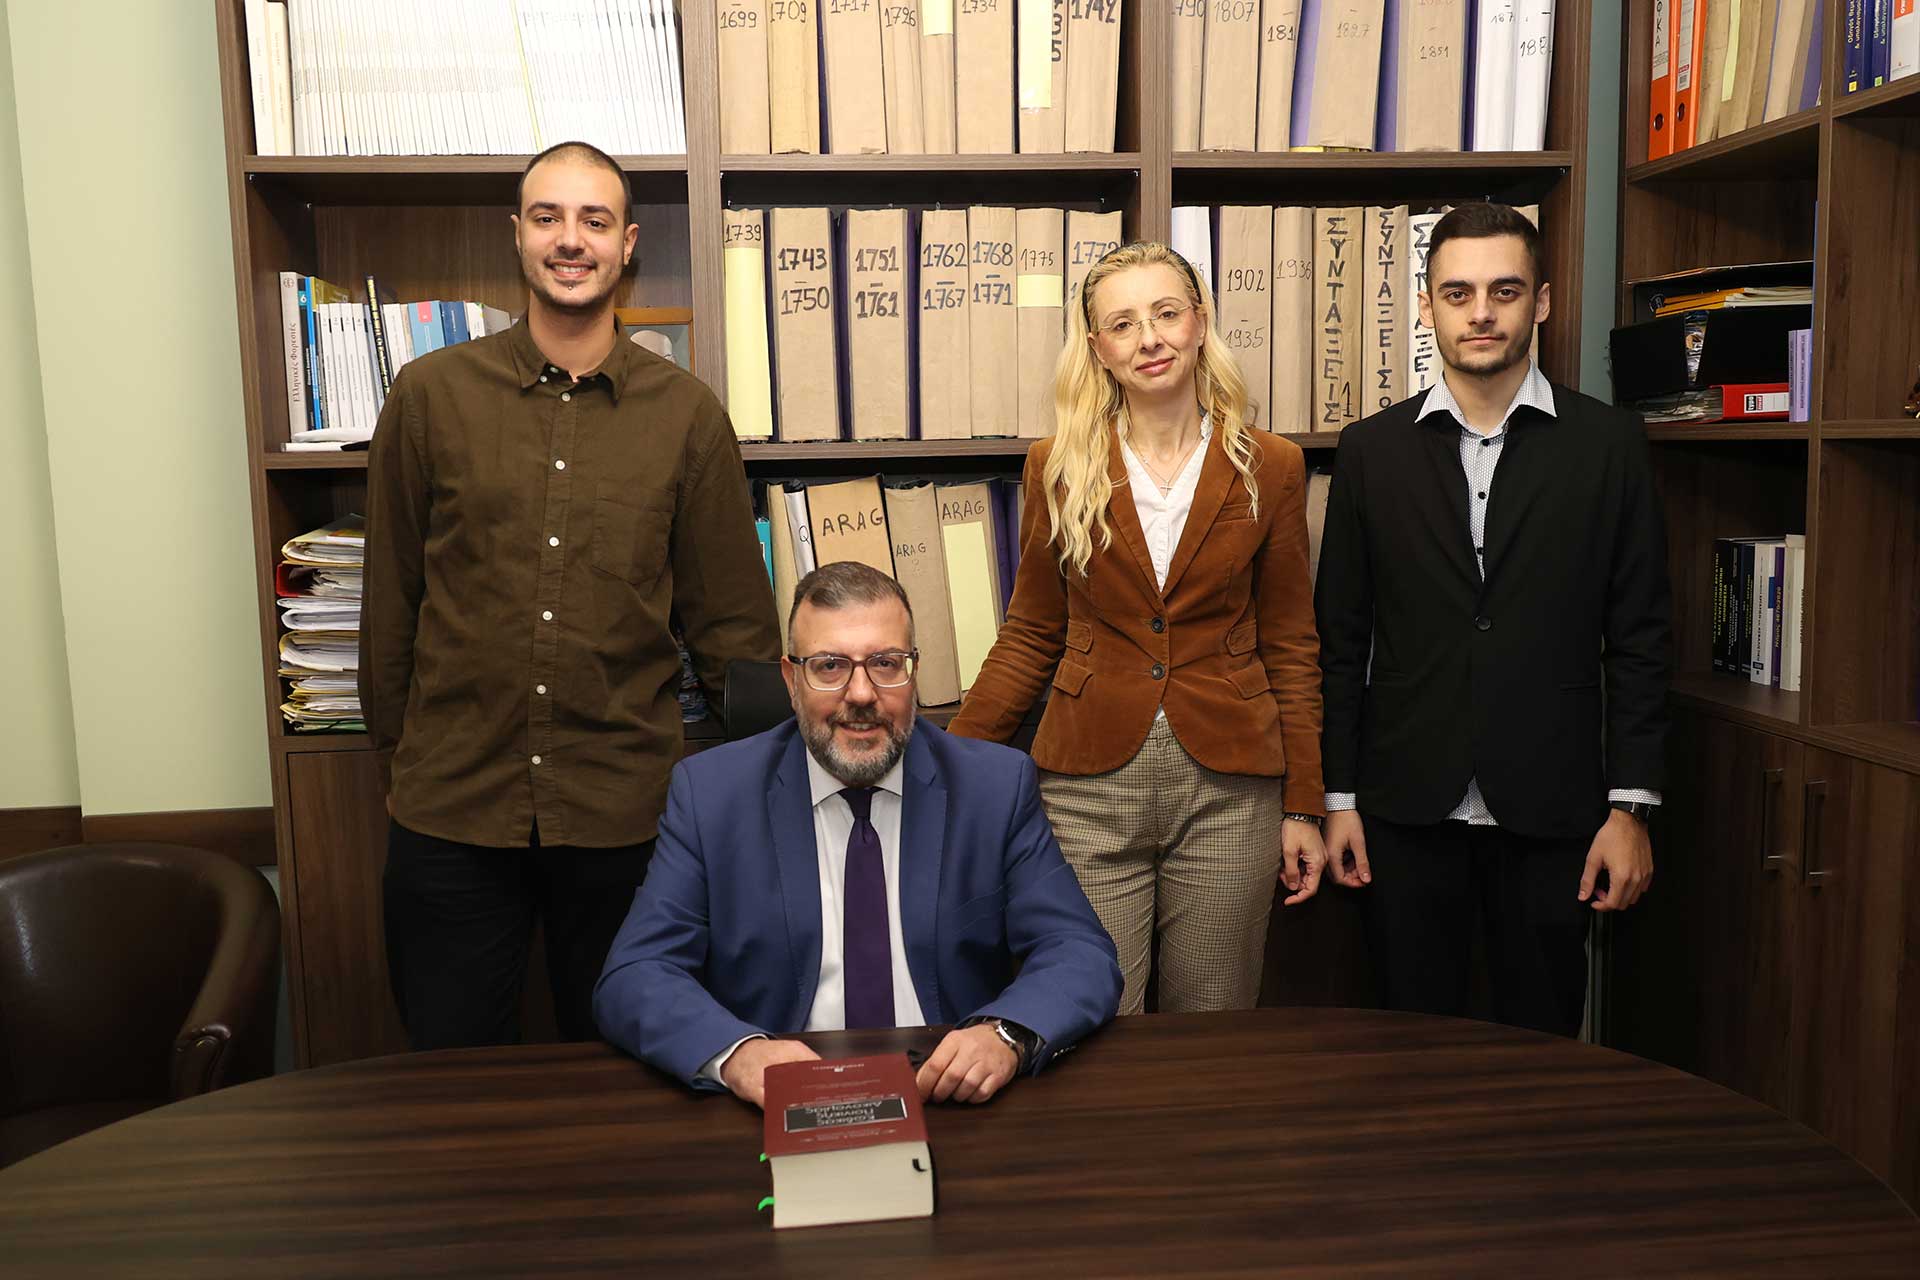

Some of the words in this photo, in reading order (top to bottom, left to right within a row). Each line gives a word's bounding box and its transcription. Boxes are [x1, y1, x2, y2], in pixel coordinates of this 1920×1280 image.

[719, 10, 758, 30] 1699
[769, 0, 807, 24] 1709
[1213, 0, 1255, 24] 1807
[724, 223, 763, 243] 1739
[777, 247, 828, 272] 1743
[855, 246, 900, 272] 1751
[922, 243, 968, 269] 1762
[972, 240, 1014, 267] 1768
[1019, 247, 1055, 271] 1775
[1226, 268, 1266, 293] 1902
[1275, 258, 1313, 281] 1936
[780, 286, 830, 315] 1750
[855, 290, 900, 319] 1761
[923, 288, 966, 310] 1767
[972, 283, 1013, 306] 1771
[1323, 216, 1349, 425] ΣΥΝΤΑΞΕΙΣ
[288, 322, 298, 361] Φορεσιές
[1224, 327, 1265, 349] 1935
[291, 362, 301, 403] Ελληνικές
[1341, 381, 1355, 418] 1
[821, 507, 885, 537] ARAG
[941, 500, 986, 521] ARAG
[895, 542, 927, 558] ARAG
